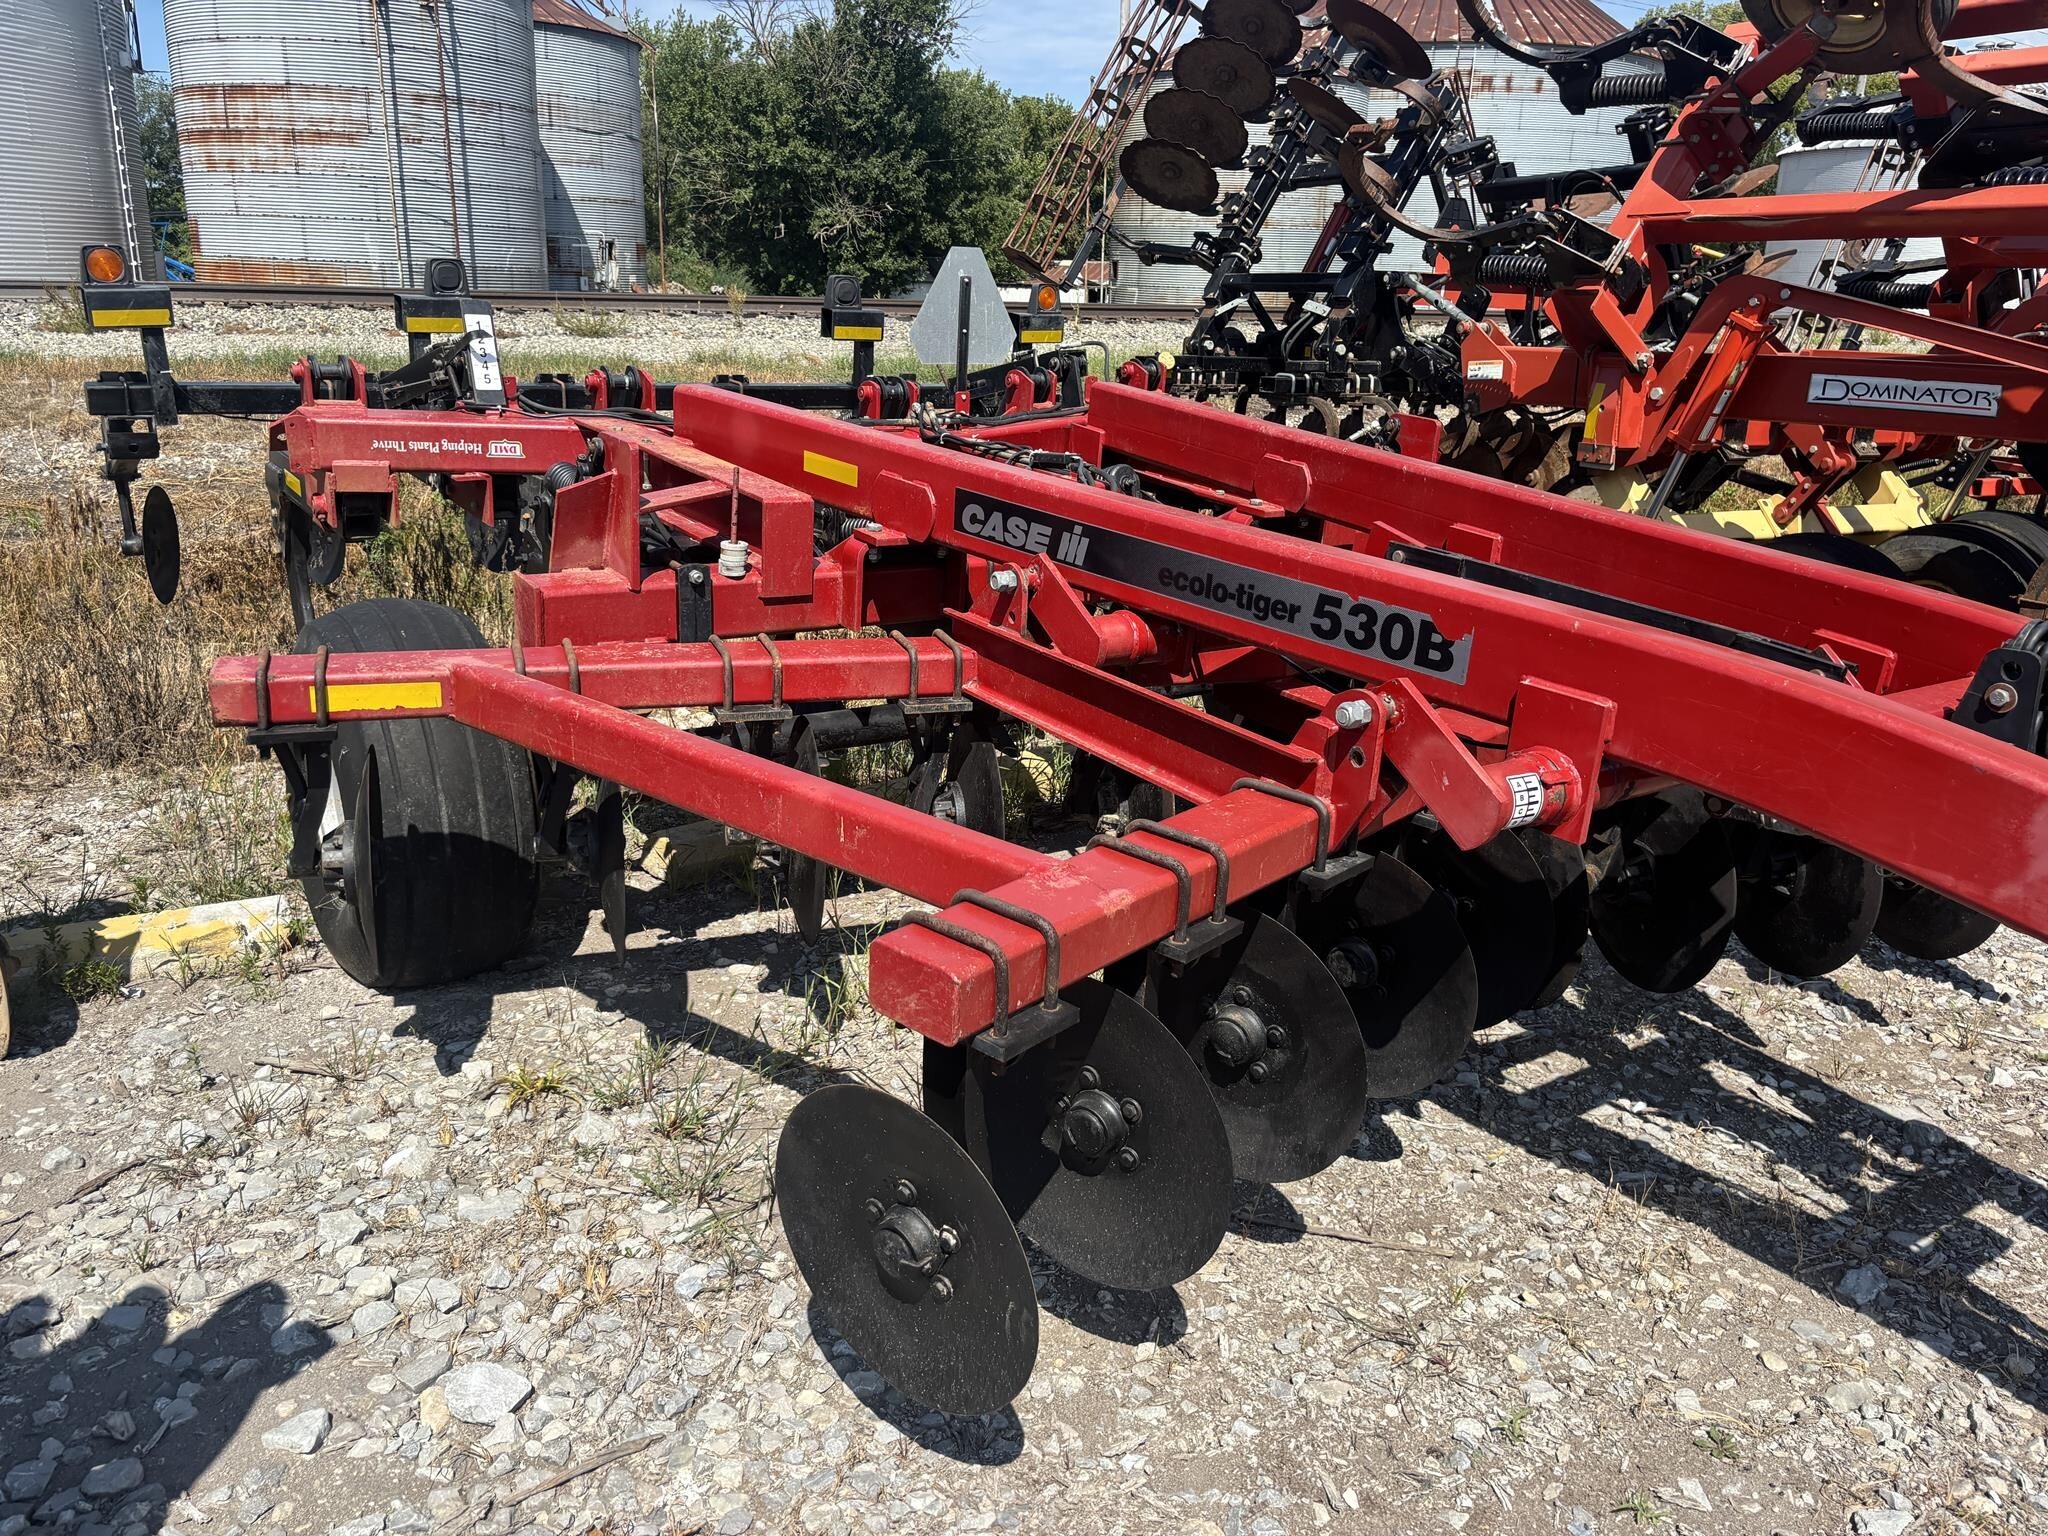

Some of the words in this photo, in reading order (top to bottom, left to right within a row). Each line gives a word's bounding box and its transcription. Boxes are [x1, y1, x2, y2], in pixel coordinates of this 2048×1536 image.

[476, 320, 481, 330] 1
[479, 347, 488, 358] 3
[482, 360, 489, 370] 4
[483, 373, 492, 384] 5
[1812, 378, 1993, 407] DOMINATOR
[372, 439, 407, 453] Thrive
[408, 440, 440, 454] Plants
[441, 439, 482, 455] Helping
[961, 503, 1053, 554] CASE
[1157, 566, 1302, 625] ecolo-tiger
[1309, 592, 1456, 673] 530B
